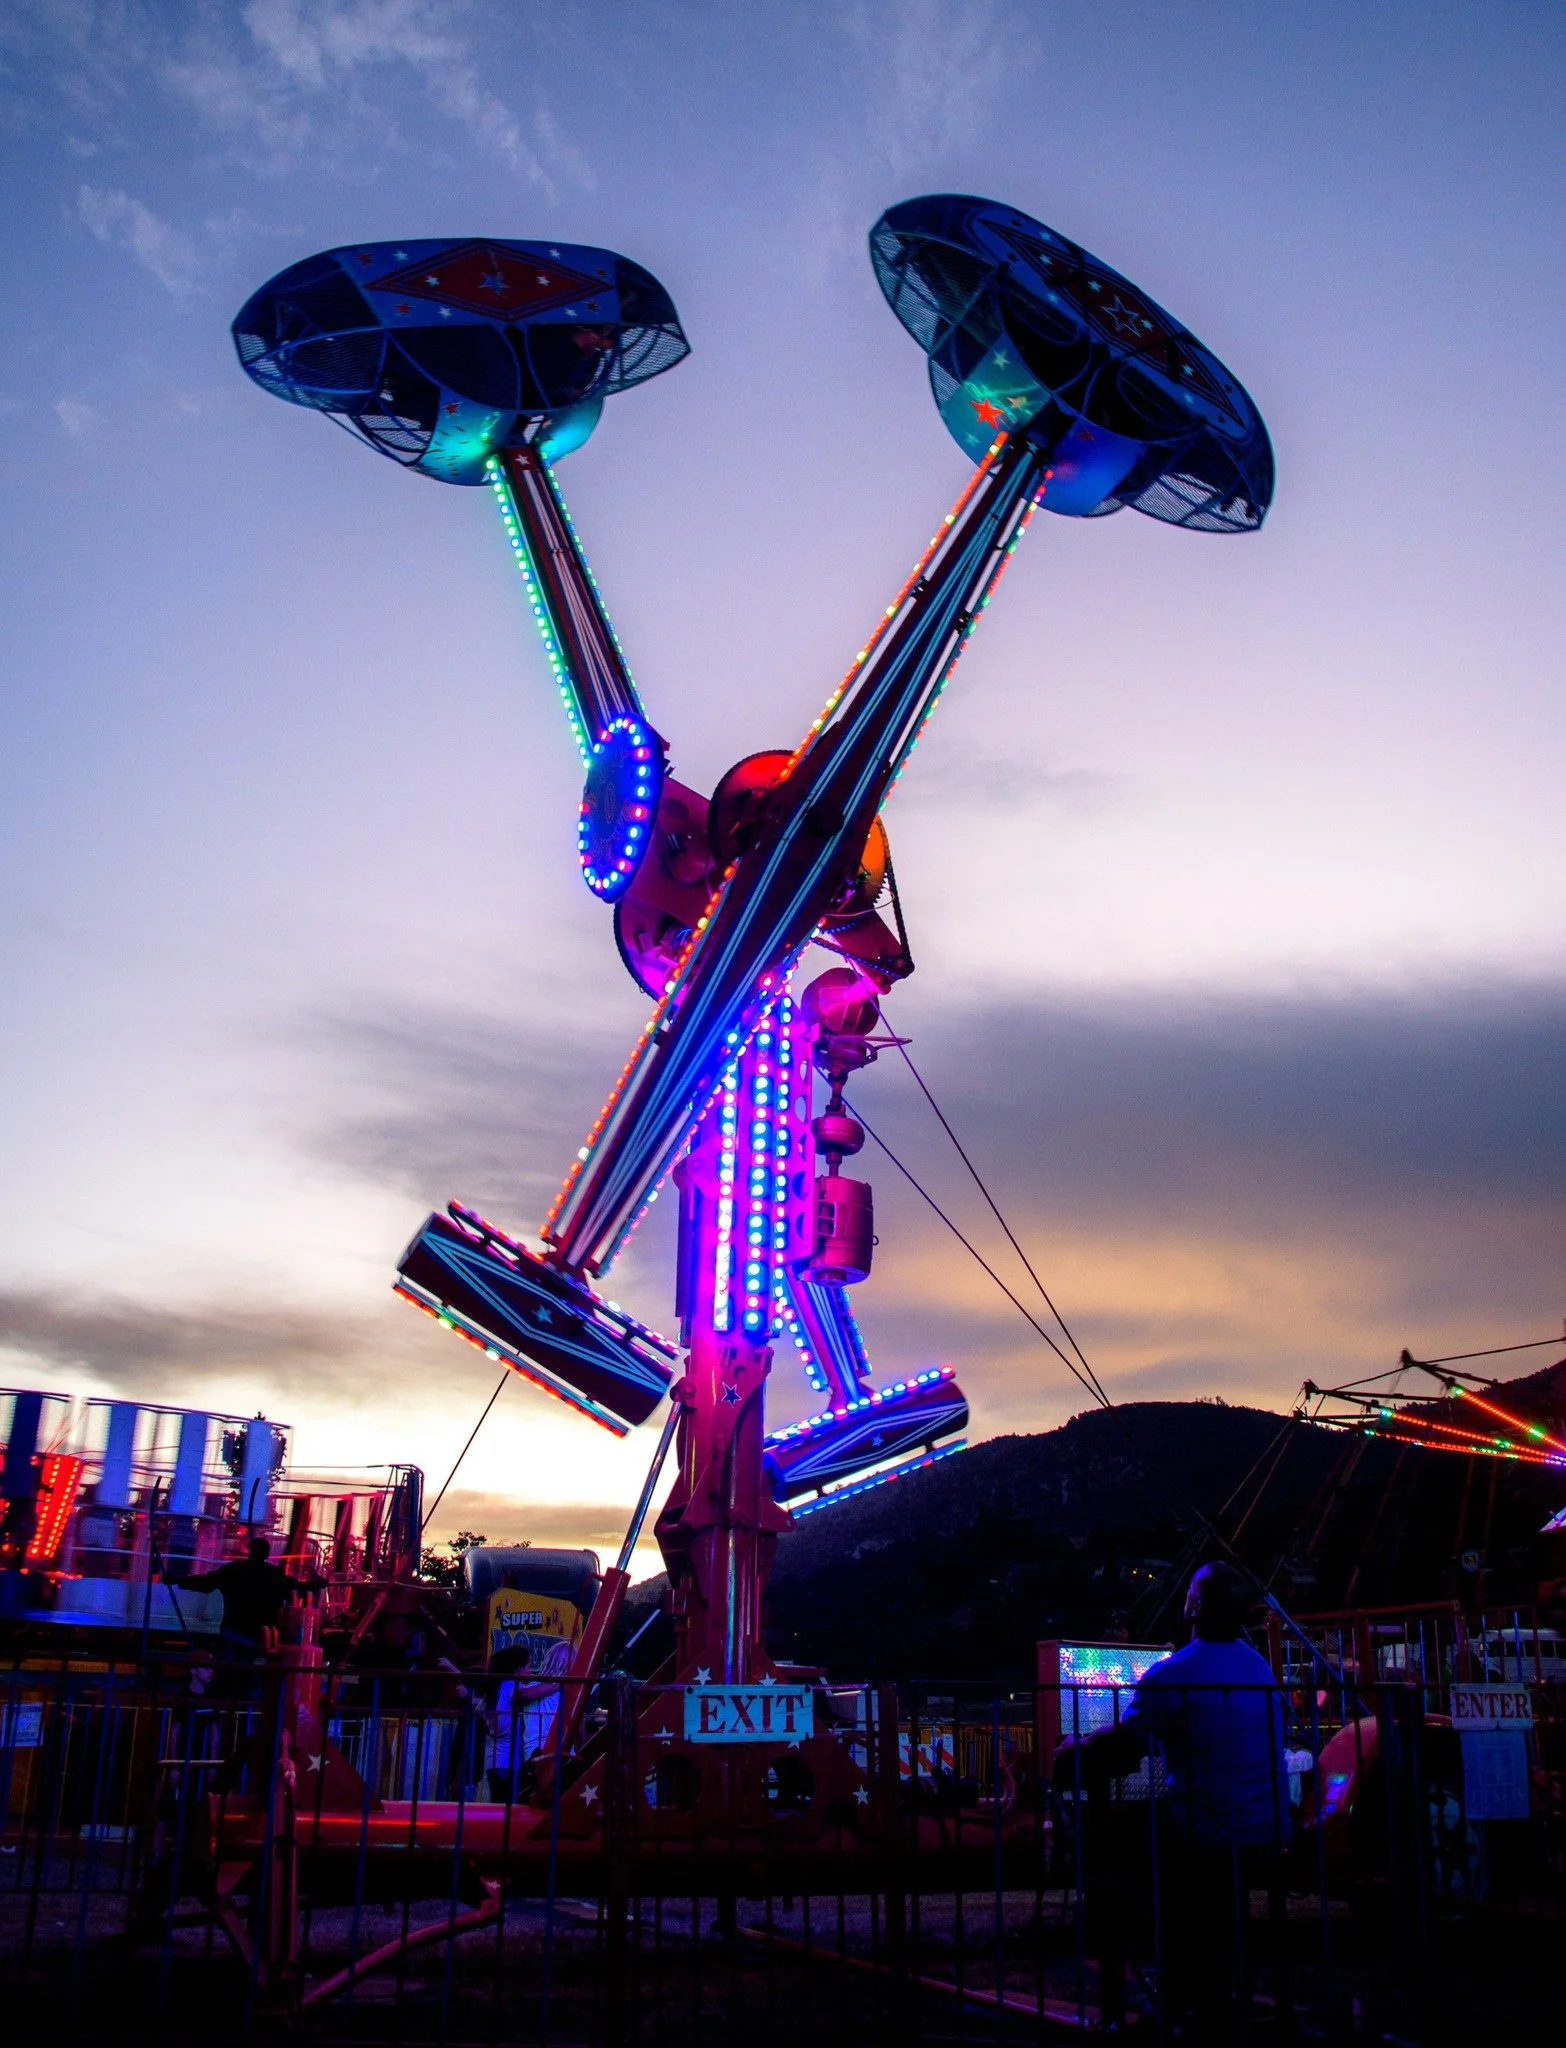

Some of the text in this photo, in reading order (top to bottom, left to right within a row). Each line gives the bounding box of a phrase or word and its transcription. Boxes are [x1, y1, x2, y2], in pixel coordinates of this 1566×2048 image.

[502, 1612, 542, 1627] SUPER
[698, 1695, 804, 1733] EXIT
[1455, 1692, 1530, 1718] ENTER
